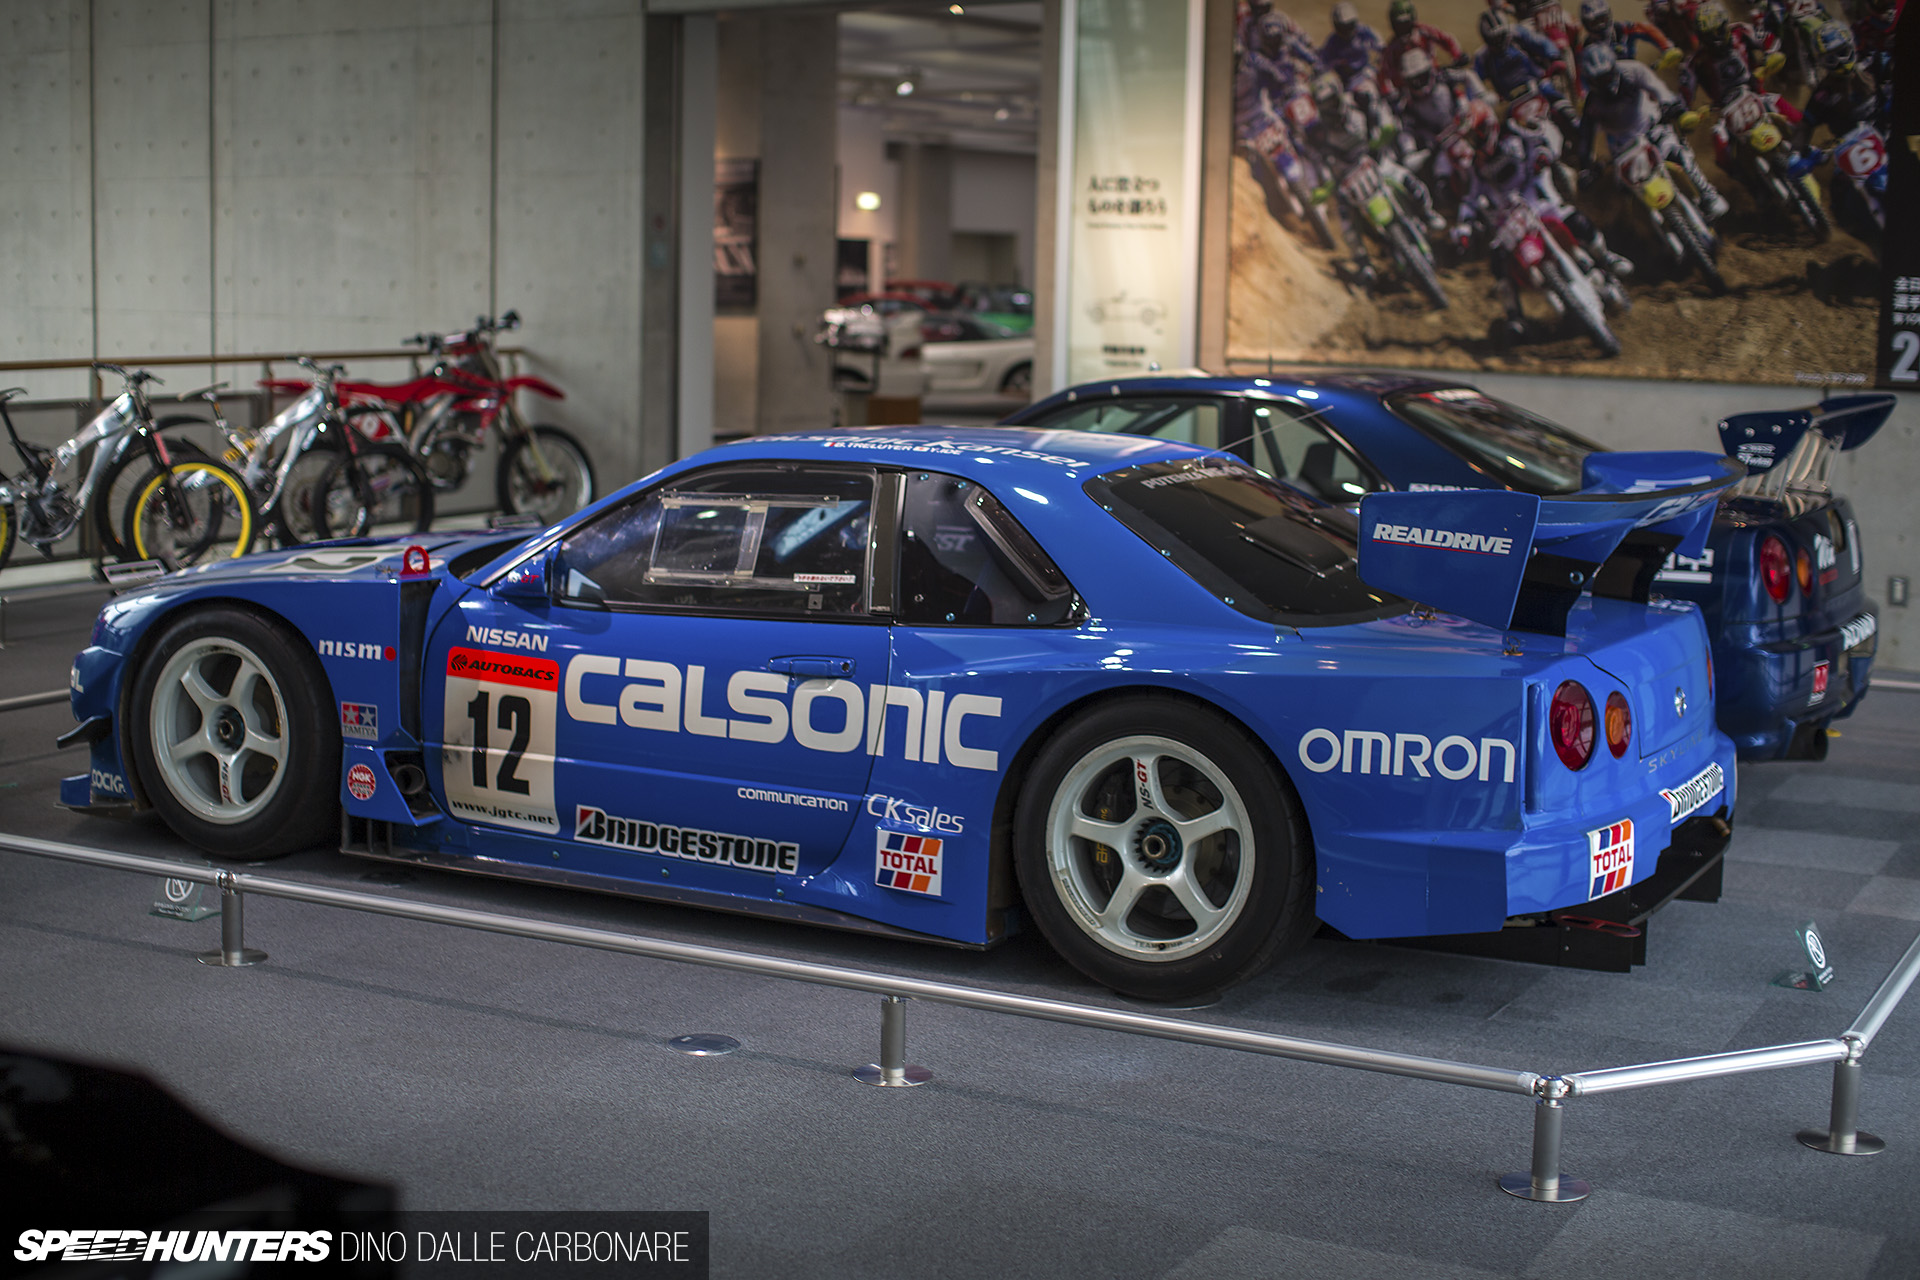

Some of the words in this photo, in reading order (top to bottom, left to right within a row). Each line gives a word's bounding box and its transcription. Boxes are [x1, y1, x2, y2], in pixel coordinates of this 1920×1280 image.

[1373, 523, 1513, 555] REALDRIVE
[466, 626, 548, 652] NISSAN
[468, 660, 554, 681] AUTOBACS
[343, 725, 377, 737] TAMIYA
[467, 690, 531, 796] 12
[1298, 728, 1516, 783] OMRON
[452, 800, 554, 826] www.jgtc.net
[577, 806, 798, 873] BRIDGESTONE
[880, 850, 938, 875] TOTAL
[1594, 844, 1632, 873] TOTAL
